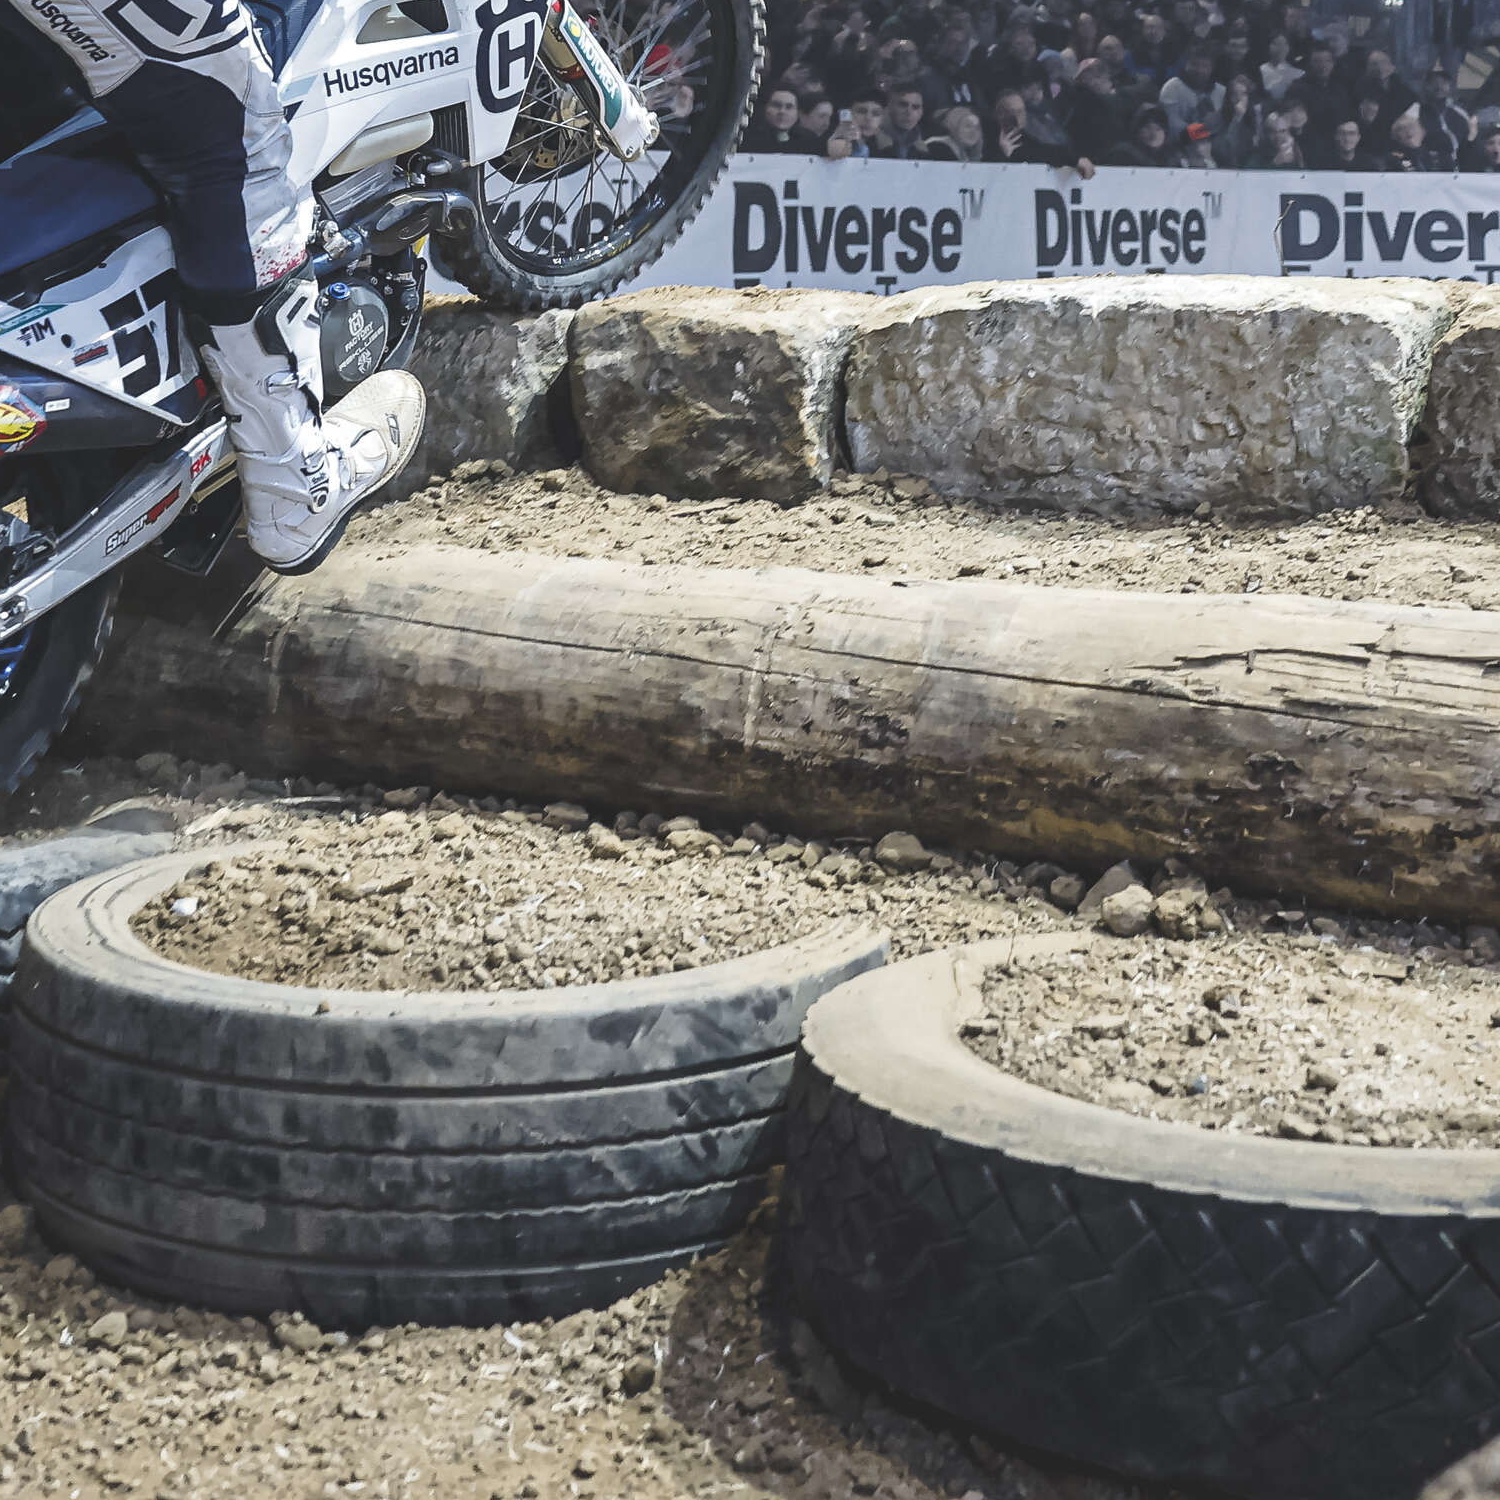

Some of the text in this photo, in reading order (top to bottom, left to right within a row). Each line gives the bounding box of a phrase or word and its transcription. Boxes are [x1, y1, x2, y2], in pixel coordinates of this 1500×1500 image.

[323, 45, 460, 98] Husqvarna
[733, 180, 962, 275] Diverse
[1035, 188, 1206, 268] Diverse
[18, 318, 56, 347] FIM
